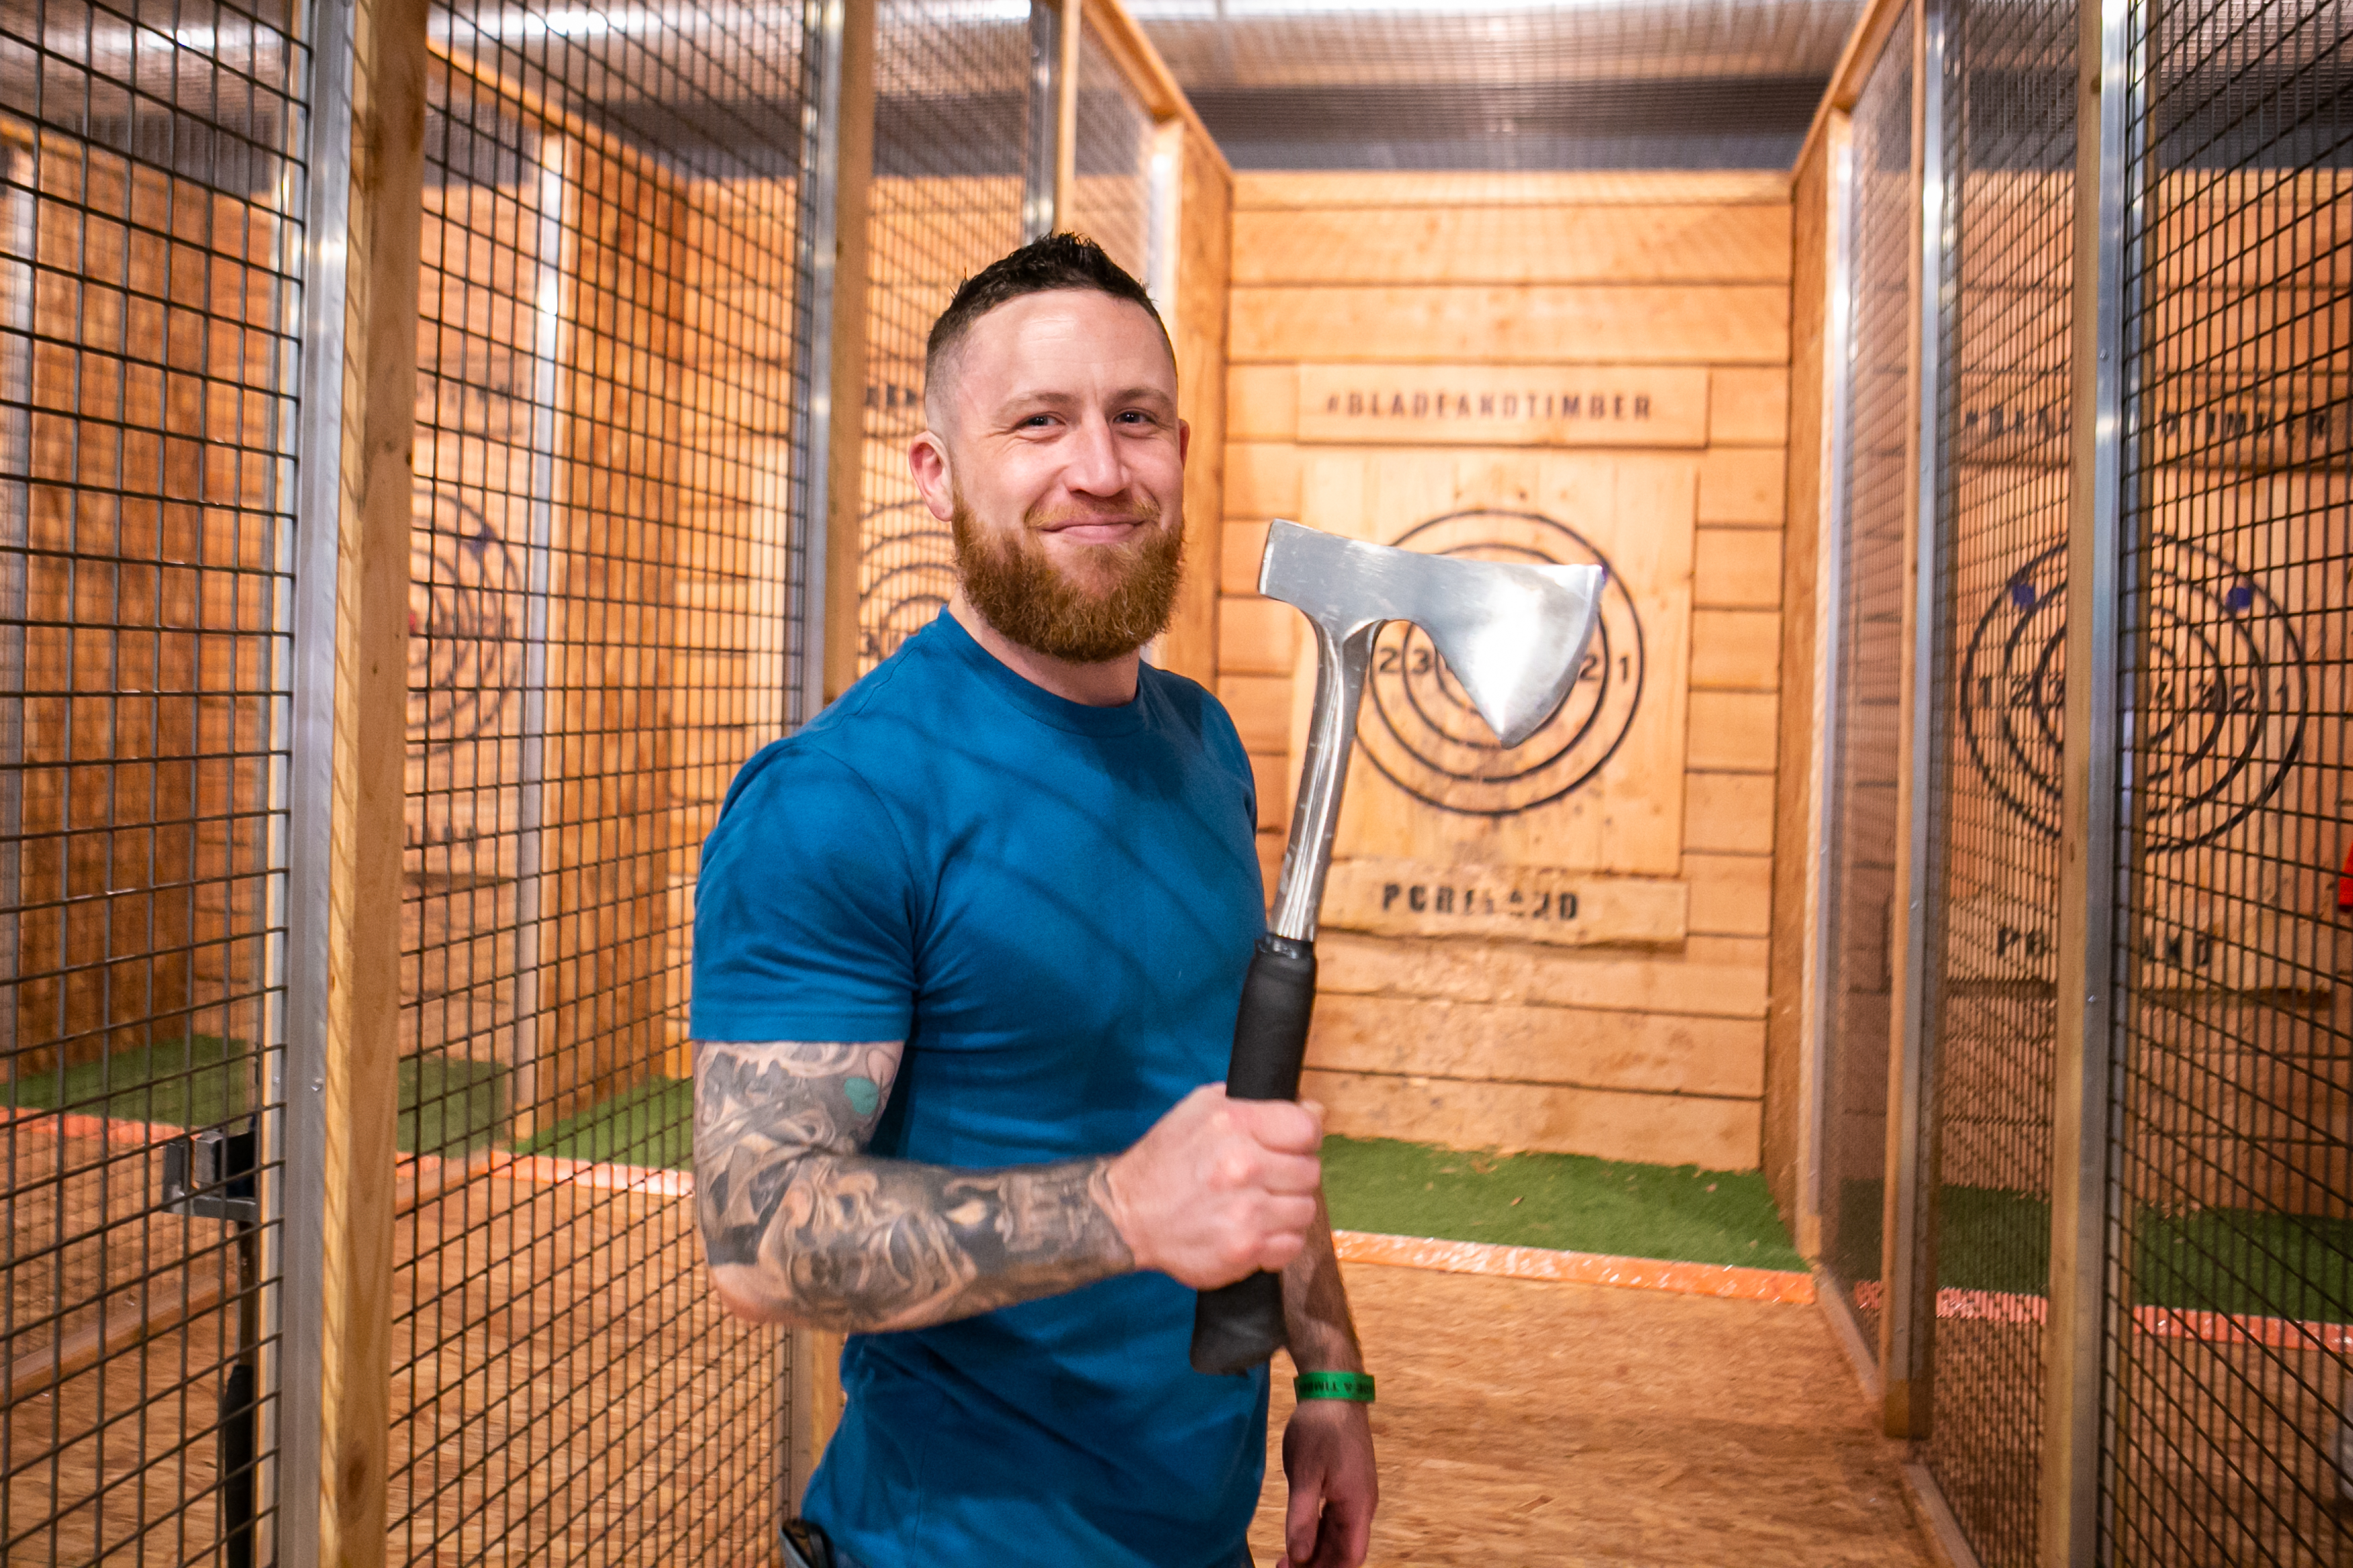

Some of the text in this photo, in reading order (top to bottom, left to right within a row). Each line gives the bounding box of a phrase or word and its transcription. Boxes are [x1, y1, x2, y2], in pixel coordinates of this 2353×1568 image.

[1379, 647, 1628, 683] 2 3 2 1
